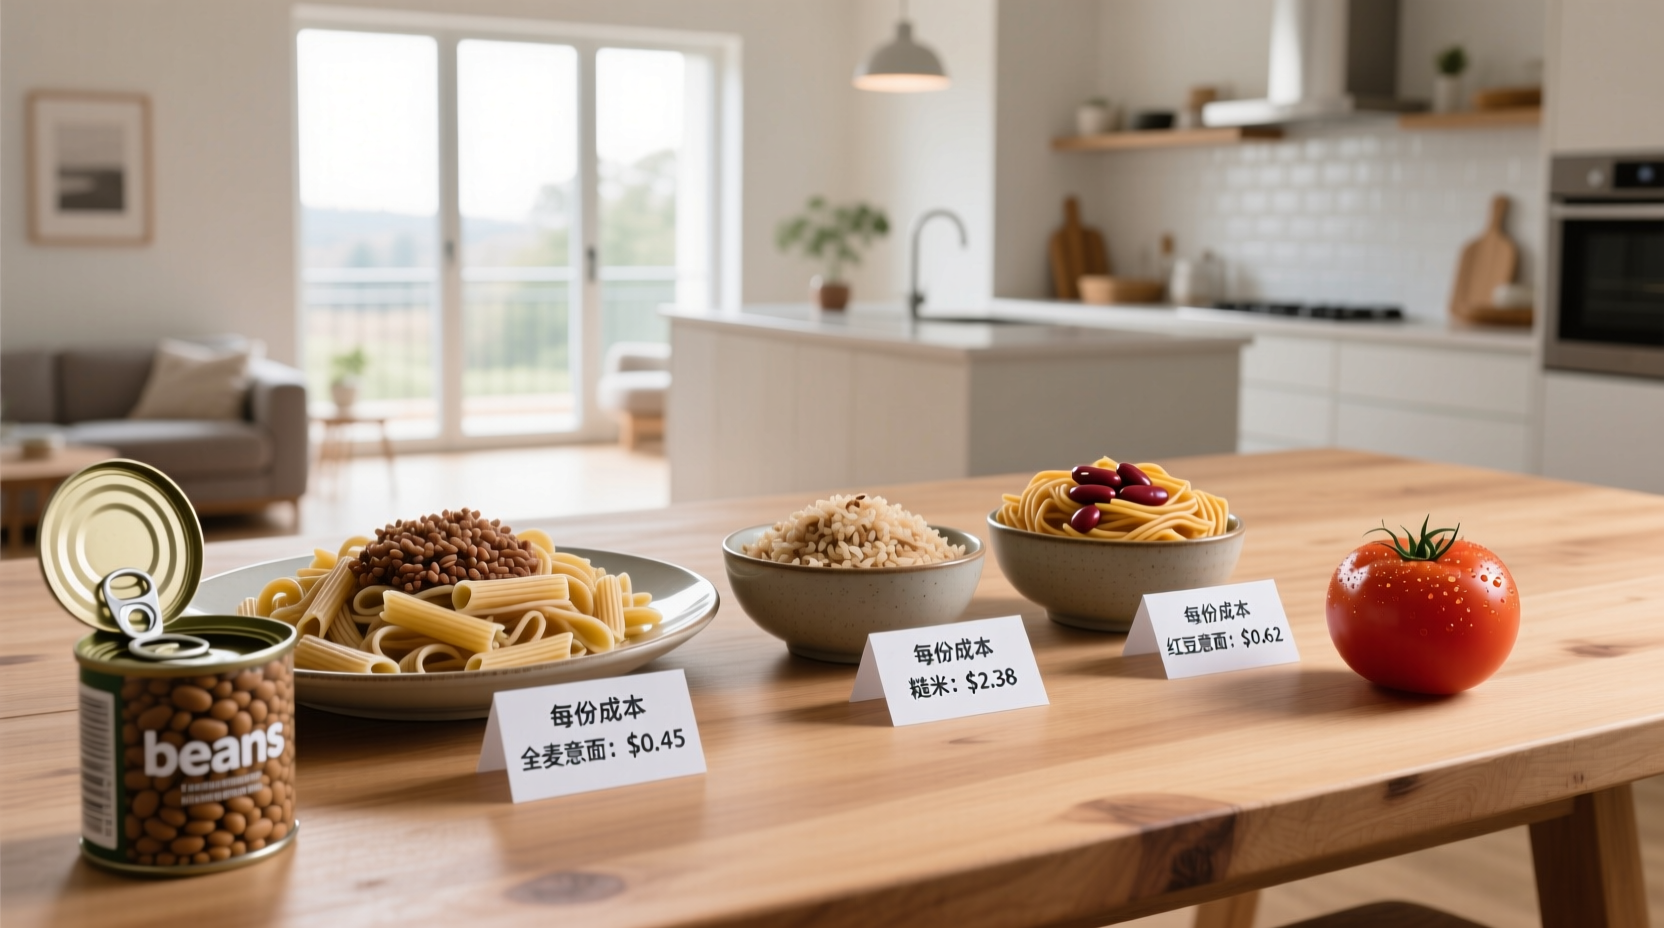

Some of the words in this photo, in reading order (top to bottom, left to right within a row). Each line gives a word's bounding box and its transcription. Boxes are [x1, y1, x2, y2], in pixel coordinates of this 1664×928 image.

[1184, 600, 1250, 625] 每份成本
[914, 636, 994, 665] 每份成本
[550, 694, 646, 728] 每份成本
[144, 721, 285, 777] beans
